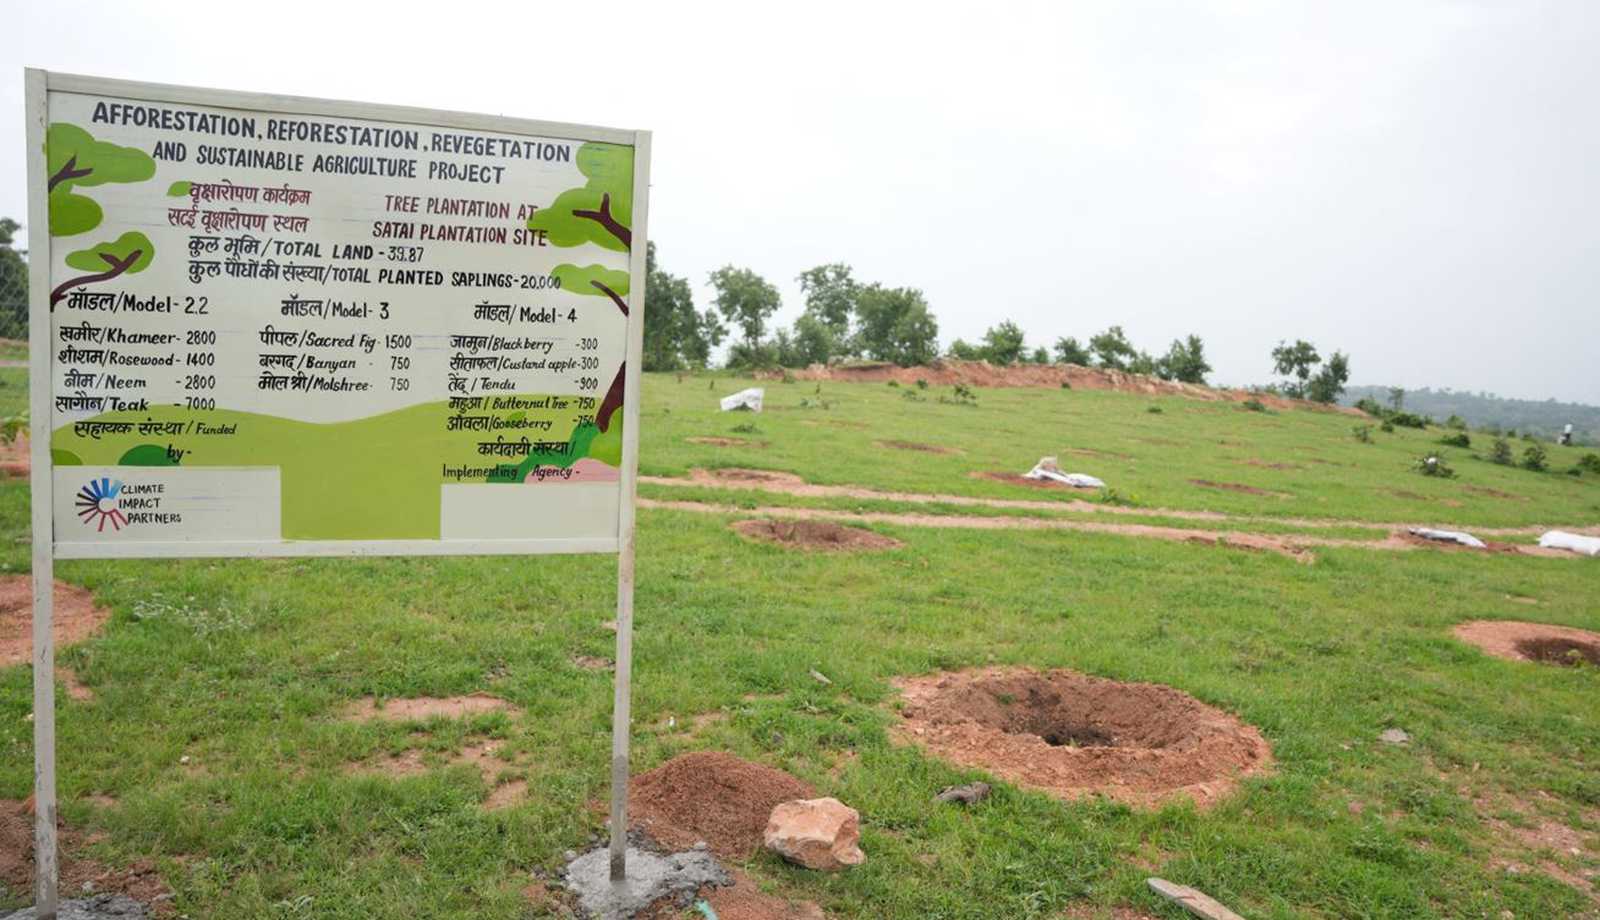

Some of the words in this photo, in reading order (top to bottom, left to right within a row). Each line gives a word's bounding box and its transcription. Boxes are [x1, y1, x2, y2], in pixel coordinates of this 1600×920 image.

[432, 133, 570, 162] REVEGETATION
[152, 141, 186, 162] AND
[199, 145, 303, 171] SUSTAINABLE
[312, 154, 417, 178] AGRICULTURE
[429, 161, 505, 184] PROJECT
[189, 179, 259, 203] वृक्षारोपण
[262, 183, 312, 205] कार्यक्रम
[385, 194, 420, 213] TREE
[426, 198, 510, 219] PLANTATION
[517, 204, 538, 221] AT
[201, 208, 269, 233] वृक्षारोपण
[273, 215, 309, 233] स्थल
[372, 221, 414, 239] SATAI
[420, 224, 506, 244] PLANTATION
[513, 228, 548, 247] SITE
[188, 236, 221, 257] कुल
[333, 244, 373, 260] LAND
[188, 260, 221, 284] कुल
[378, 269, 443, 285] PLANTED
[185, 297, 208, 314] 2.2
[379, 302, 389, 319] 3
[567, 308, 577, 322] 4
[186, 331, 216, 345] 2800
[385, 335, 412, 349] 1500
[186, 353, 215, 366] 1400
[391, 356, 410, 370] 750
[390, 377, 409, 391] 750
[74, 420, 134, 439] सहायक
[195, 423, 236, 434] Funded
[443, 464, 518, 481] Implementing
[121, 484, 164, 495] CLIMATE
[118, 498, 160, 509] IMPACT
[127, 513, 182, 523] PARTNERS
